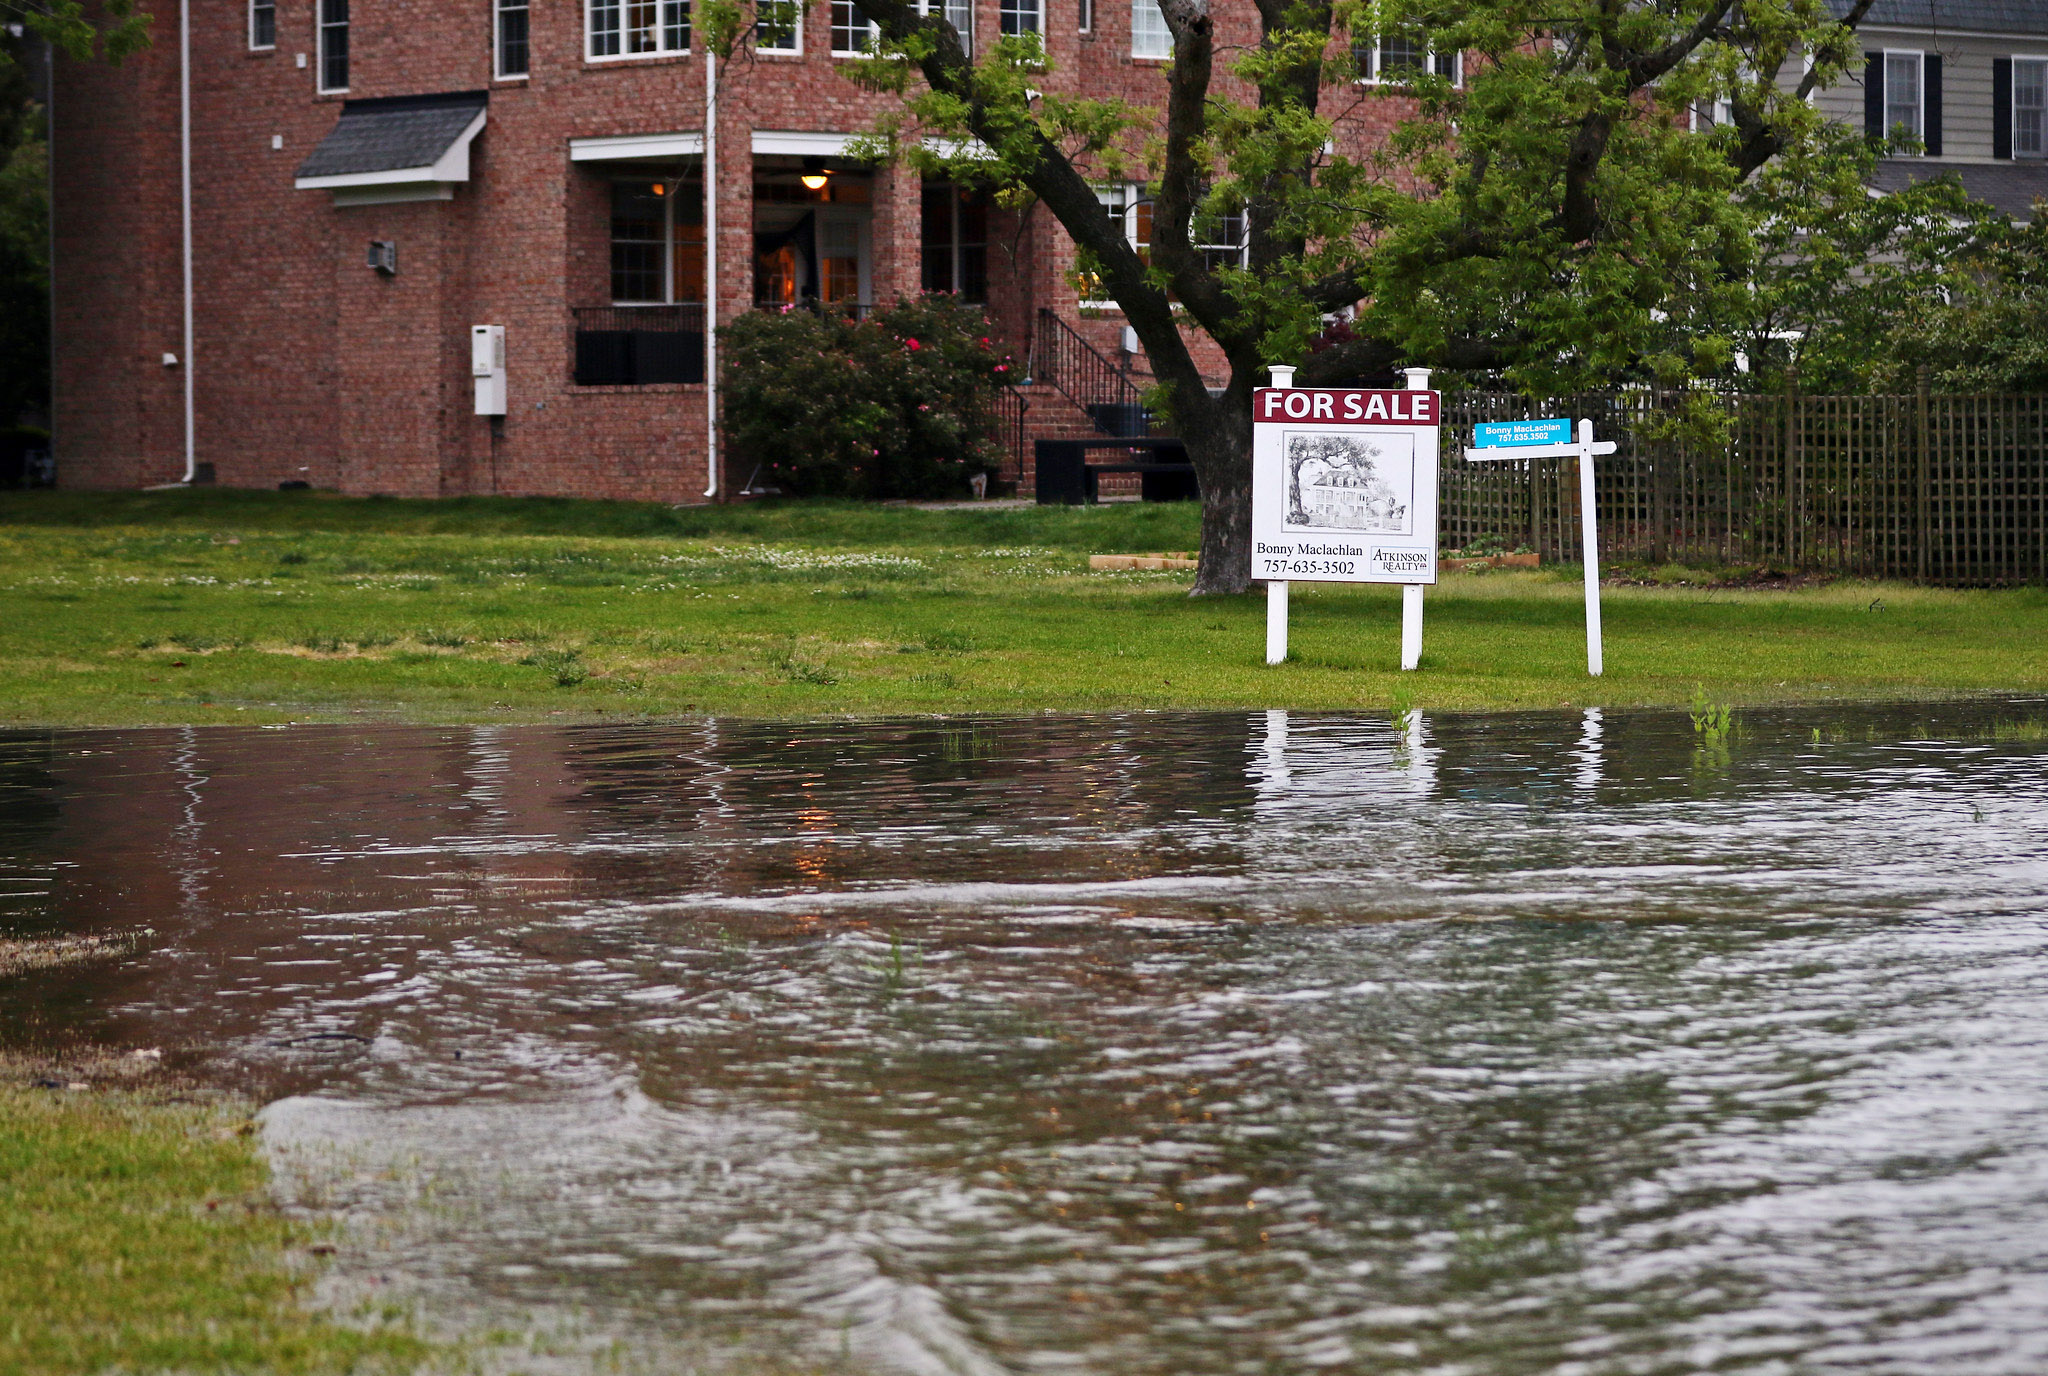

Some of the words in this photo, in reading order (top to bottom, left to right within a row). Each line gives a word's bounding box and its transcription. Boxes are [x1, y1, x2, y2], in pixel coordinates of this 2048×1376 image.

[1264, 391, 1335, 419] FOR
[1343, 393, 1431, 421] SALE
[1486, 426, 1511, 435] Bonny
[1514, 424, 1560, 433] MacLachlan
[1498, 432, 1548, 442] 757.635.3502
[1257, 542, 1294, 557] Bonny
[1298, 543, 1363, 556] Maclachlan
[1373, 548, 1427, 562] ATKINSON
[1264, 559, 1355, 575] 757-635-3502
[1383, 562, 1420, 573] REALTY
